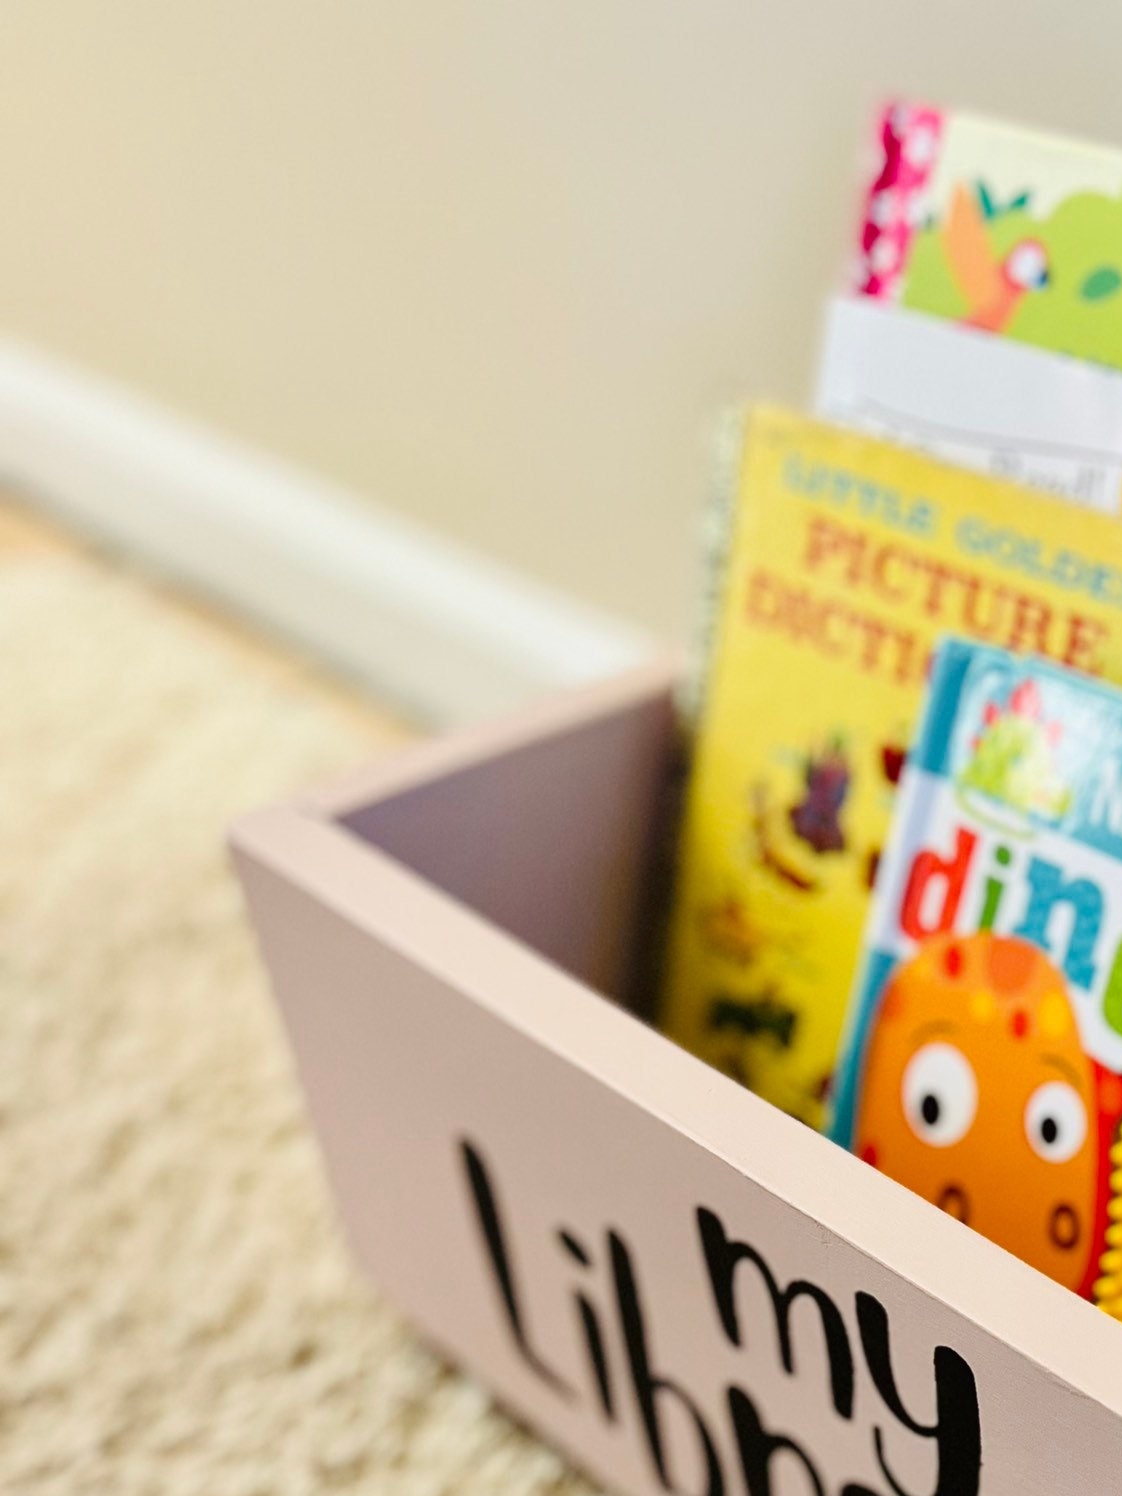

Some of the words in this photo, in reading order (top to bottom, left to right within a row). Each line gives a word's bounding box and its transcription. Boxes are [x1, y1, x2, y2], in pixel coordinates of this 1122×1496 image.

[783, 450, 939, 538] LITTLE
[746, 566, 937, 690] DICTI
[804, 515, 1110, 677] PICTURE
